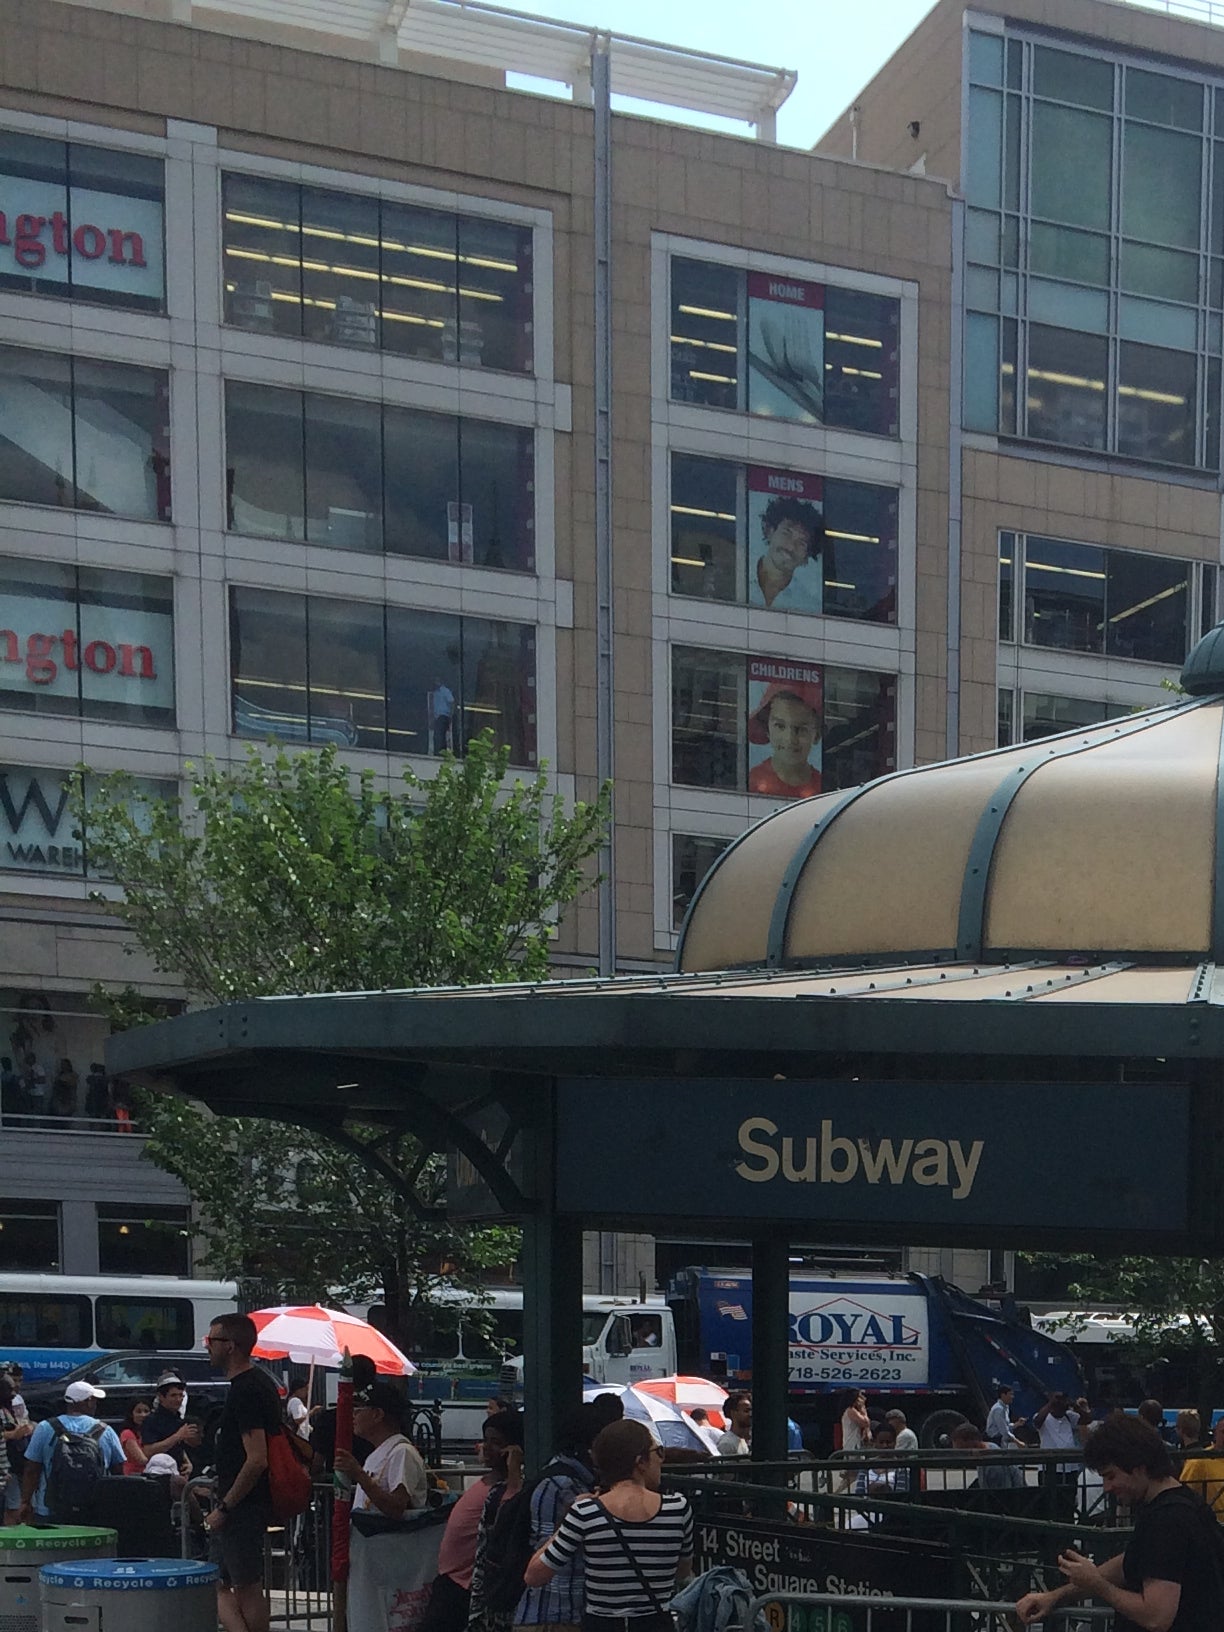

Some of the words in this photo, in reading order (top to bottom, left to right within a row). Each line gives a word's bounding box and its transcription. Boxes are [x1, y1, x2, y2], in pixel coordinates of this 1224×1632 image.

[0, 210, 147, 268] gton
[768, 281, 806, 300] HOME
[768, 475, 804, 493] MENS
[751, 662, 819, 684] CHILDRENS
[734, 1116, 984, 1200] Subway
[789, 1350, 816, 1360] aste
[820, 1348, 887, 1364] Services,
[890, 1350, 917, 1362] Inc.
[787, 1366, 902, 1381] 718-526-2623
[35, 1536, 87, 1549] Recycle
[700, 1527, 719, 1554] 14
[725, 1530, 781, 1563] Street
[93, 1577, 153, 1590] Recycle
[753, 1563, 819, 1594] Square
